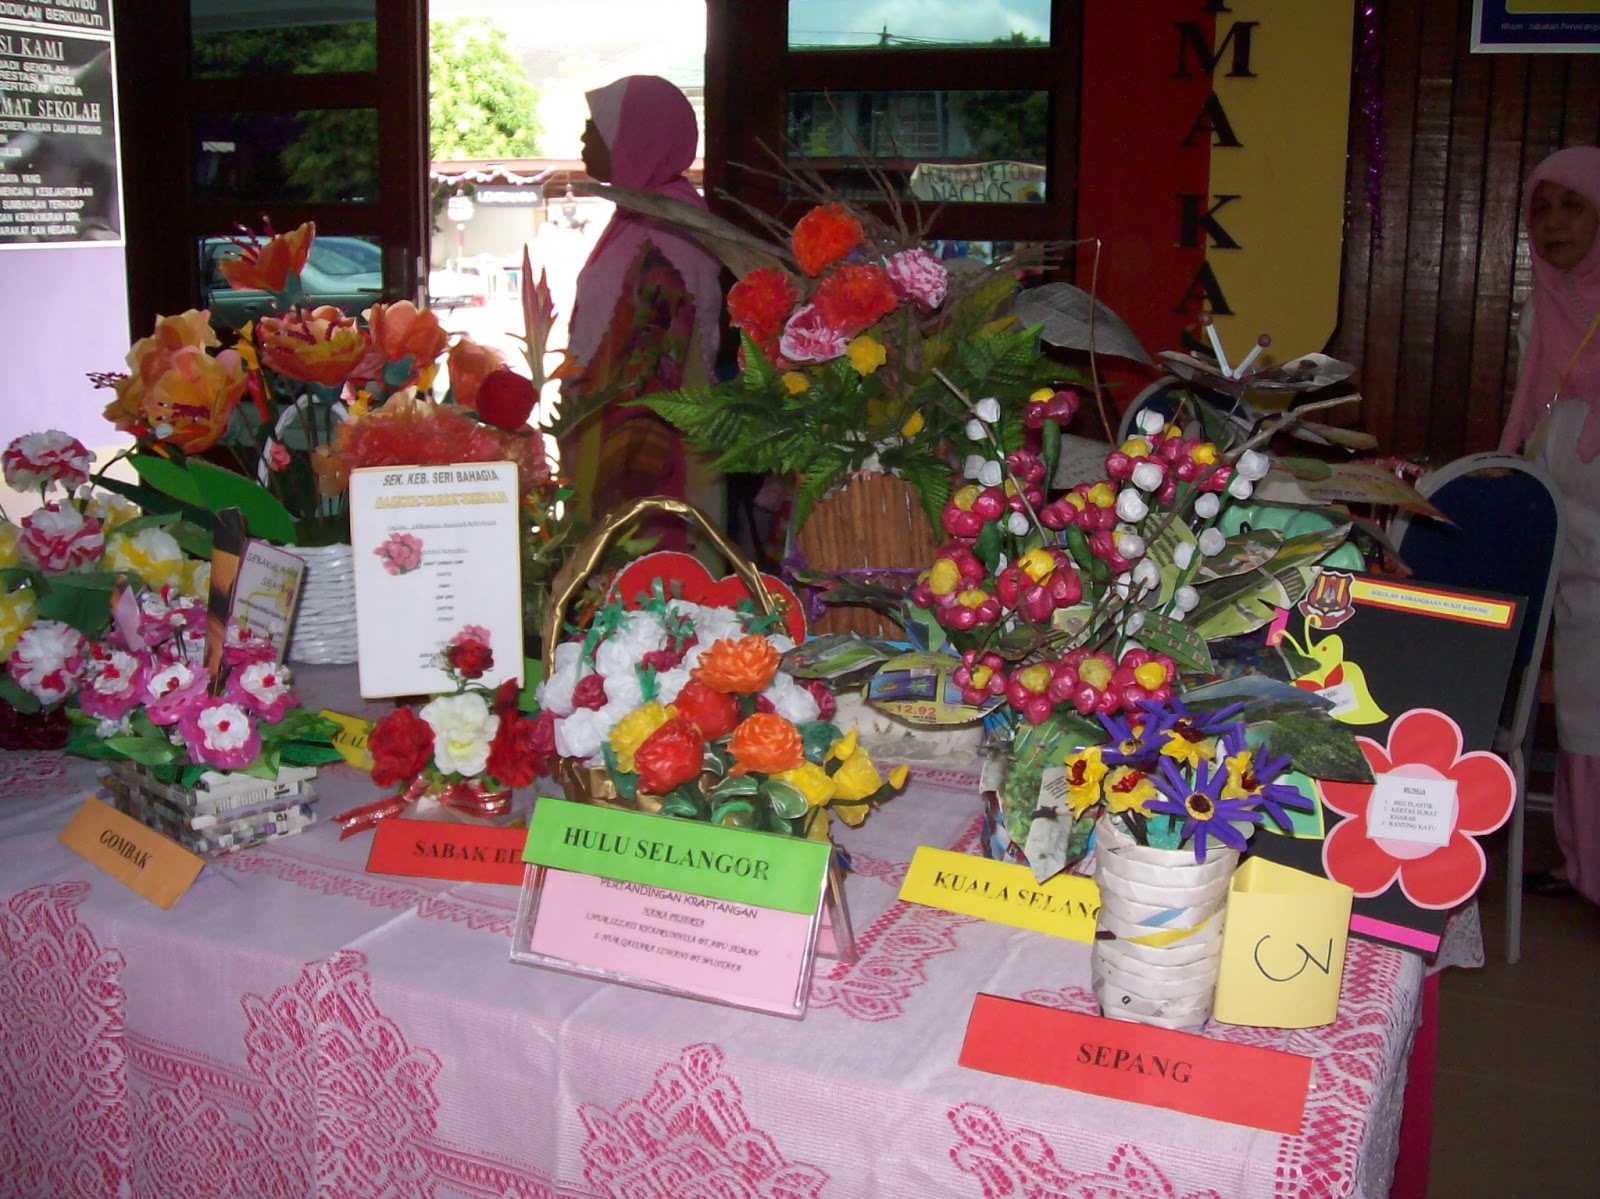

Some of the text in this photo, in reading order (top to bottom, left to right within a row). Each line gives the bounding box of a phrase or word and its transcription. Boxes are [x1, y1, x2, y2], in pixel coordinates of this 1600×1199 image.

[45, 9, 103, 26] BERKUALITI
[21, 38, 64, 59] KAMI
[23, 62, 70, 74] SEKOLAH
[43, 75, 75, 85] TINGGI
[54, 86, 83, 96] DUNIA
[38, 100, 101, 121] SEKOLAH
[53, 124, 76, 133] DALAM
[77, 125, 102, 135] BIDANG
[21, 175, 41, 184] YANG
[35, 187, 94, 197] KESEJAHTERAAN
[931, 181, 1012, 201] NACHOS
[2, 200, 85, 209] SUMBANGAN TERHADAP
[15, 213, 64, 222] KEMAKMURAN
[31, 226, 46, 235] DAN
[382, 469, 499, 486] SEK. KEB. SERI BAHAGIA
[1371, 589, 1399, 599] SEKOLAH
[1400, 595, 1442, 607] KEBANGSAAN
[1442, 601, 1462, 610] BUKIT
[1403, 787, 1426, 796] BUNGA
[1407, 801, 1433, 809] PLASTIK
[1391, 807, 1416, 815] KERTAS
[1389, 821, 1417, 829] RANTING
[99, 829, 152, 870] GOMBAK
[413, 840, 489, 863] SABAK
[563, 826, 770, 881] HULU SELANGOR
[933, 871, 1009, 902] KUALA
[600, 877, 758, 920] PERTANDINGAN KRAFTANGAN
[601, 933, 620, 944] NUR
[1077, 1042, 1193, 1085] SEPANG
